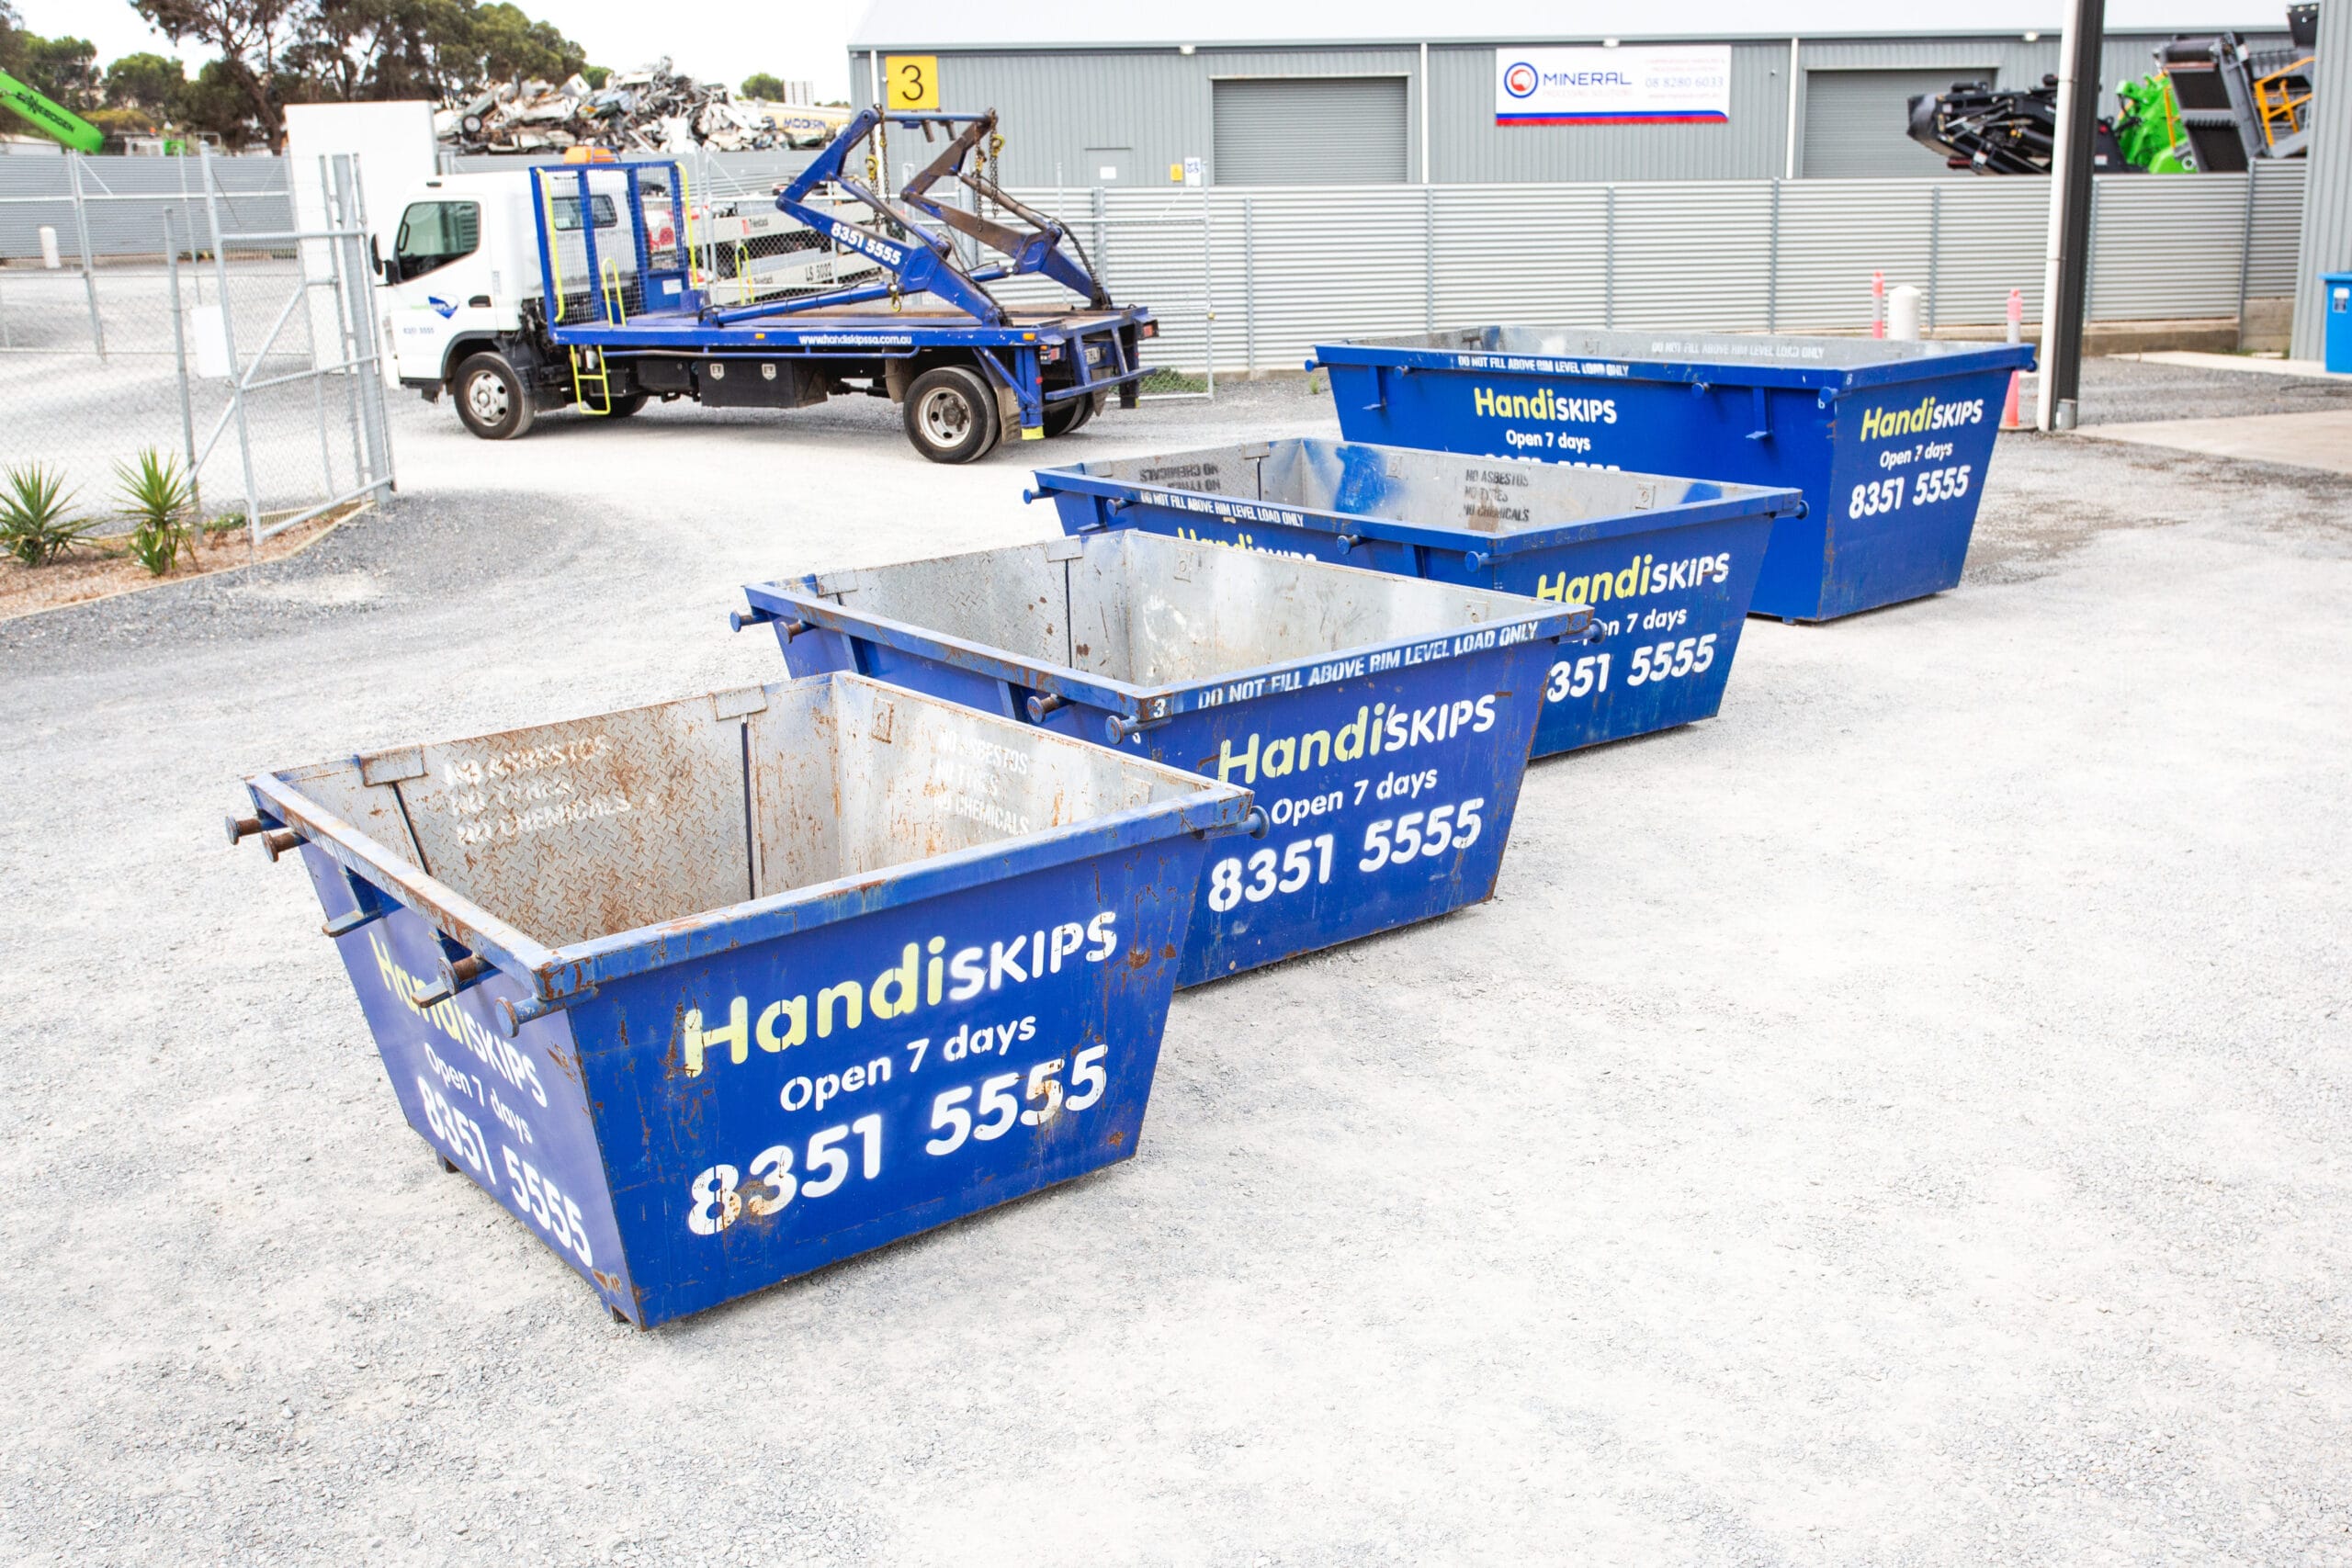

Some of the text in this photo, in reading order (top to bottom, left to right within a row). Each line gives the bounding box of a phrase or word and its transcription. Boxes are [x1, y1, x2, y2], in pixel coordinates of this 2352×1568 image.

[901, 64, 923, 101] 3
[1544, 73, 1632, 85] MINERAL
[831, 222, 901, 265] 8351 5555
[1489, 357, 1506, 368] FILL
[1555, 362, 1580, 374] LEVEL
[1474, 387, 1617, 424] HandiSKIPS
[1860, 396, 1984, 442] HandiSKIPS
[1506, 429, 1591, 454] Open 7 days
[1879, 441, 1954, 470] Open 7 days
[1465, 468, 1479, 482] NO
[1849, 465, 1972, 520] 8351 5555
[1170, 496, 1186, 509] FILL
[1188, 498, 1214, 513] ABOVE
[1232, 504, 1257, 520] LEVEL
[1257, 509, 1281, 523] LOAD
[1282, 513, 1305, 527] ONLY
[1537, 552, 1730, 604] HandiSKIPS
[1626, 613, 1639, 634] 7
[1643, 608, 1687, 631] days
[1197, 621, 1539, 710] DO NOT FILL ABOVE RIM LEVEL LOAD ONLY
[1546, 653, 1611, 703] 351
[1626, 633, 1717, 686] 5555
[1153, 698, 1167, 718] 3
[1217, 694, 1496, 784] HandiSKIPS
[1272, 769, 1438, 827] Open 7 days
[1208, 797, 1485, 913] 8351 5555
[684, 910, 1117, 1078] HandiSKIPS
[779, 1015, 1036, 1111] Open 7 days
[424, 1043, 533, 1144] Open 7 days
[687, 1043, 1109, 1236] 8351 5555
[417, 1077, 593, 1268] 8351 5555
